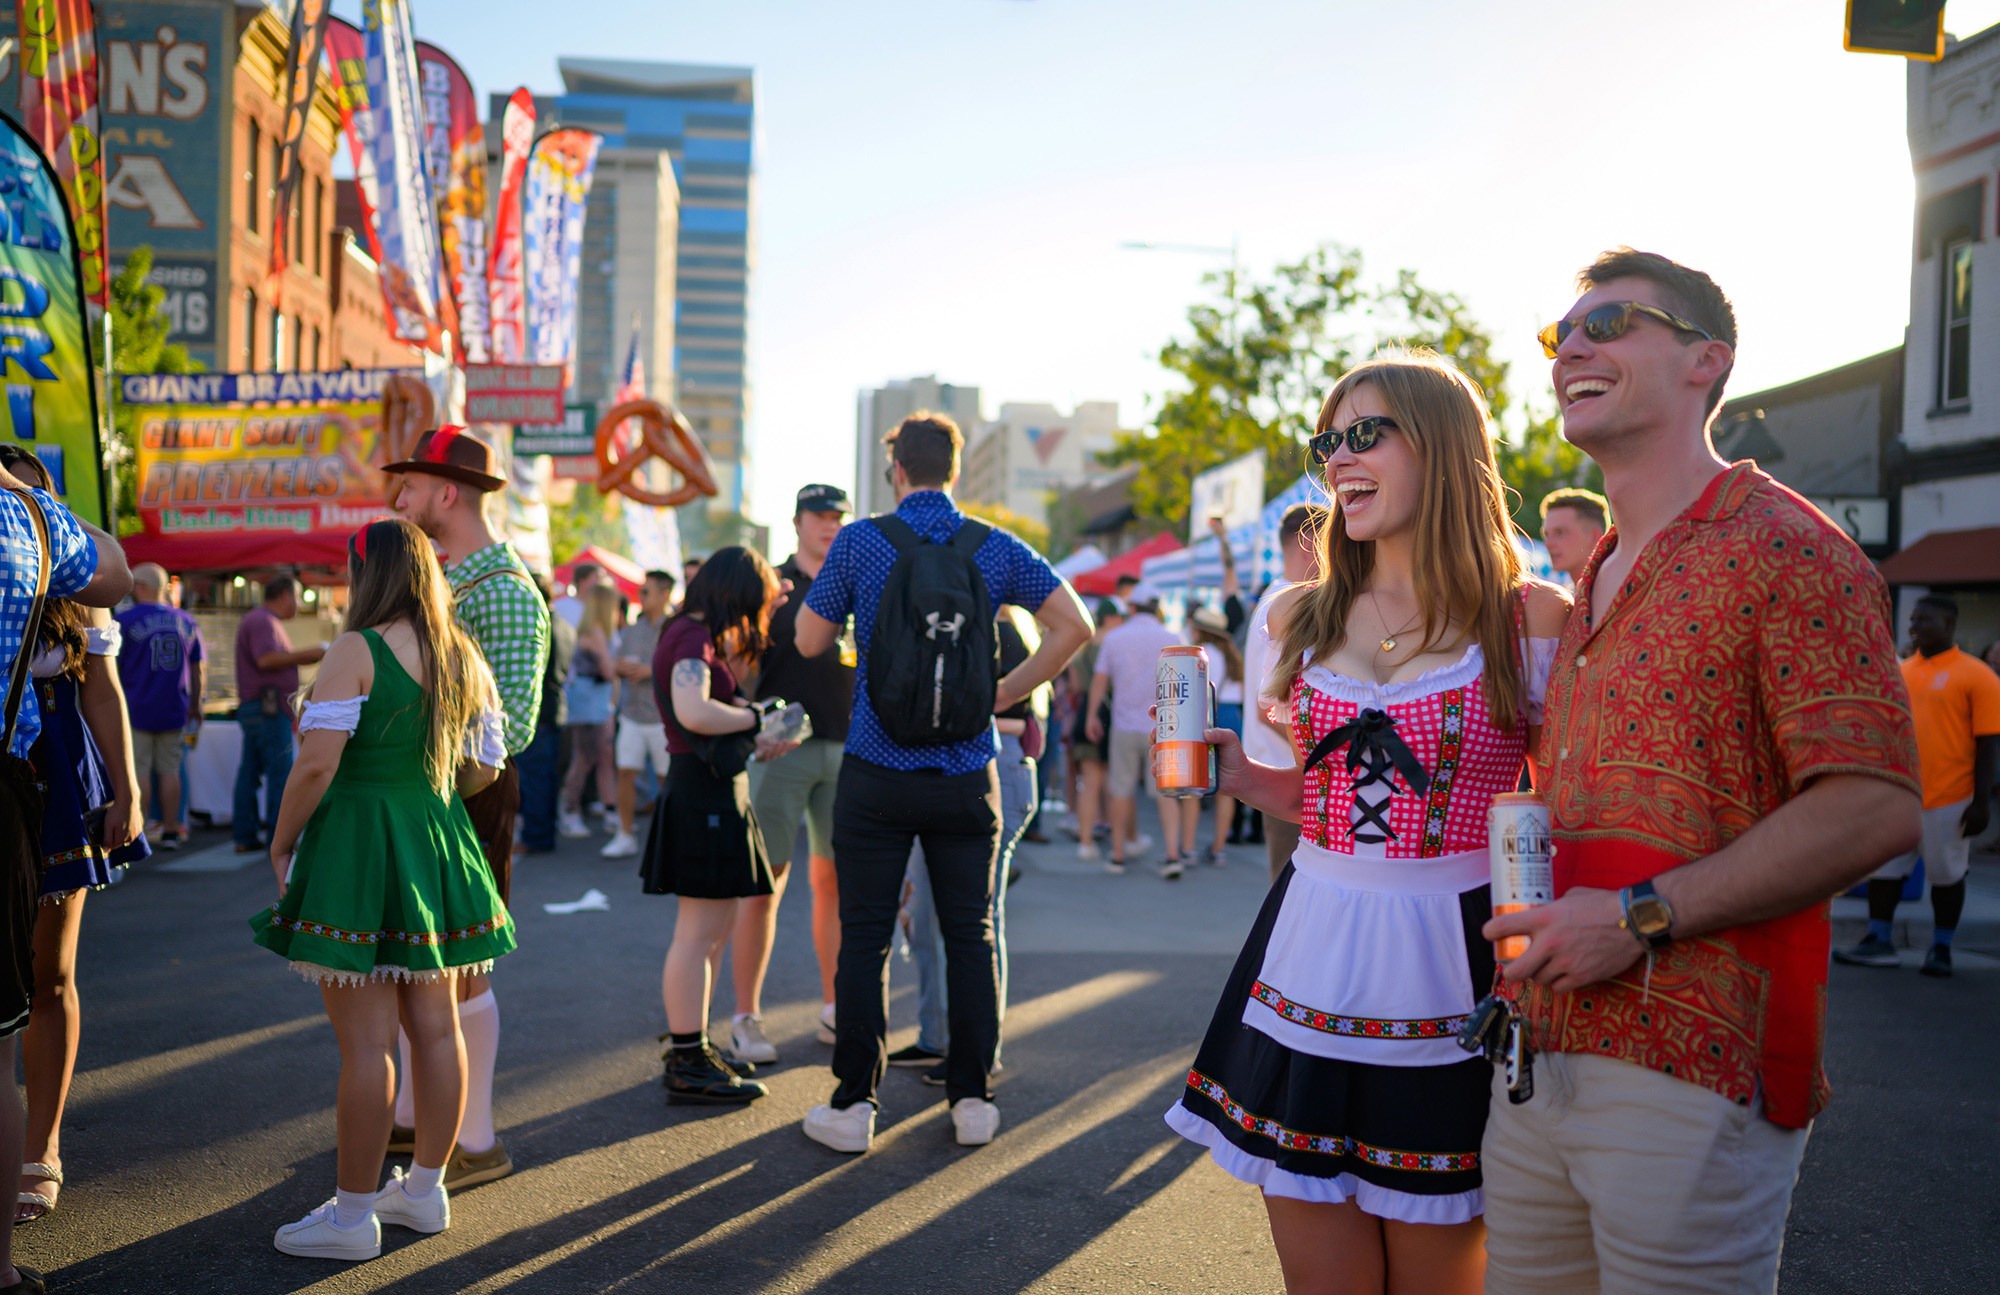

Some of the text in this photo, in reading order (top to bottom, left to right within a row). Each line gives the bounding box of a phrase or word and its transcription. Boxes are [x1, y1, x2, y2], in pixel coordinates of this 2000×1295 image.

[124, 375, 222, 402] GIANT
[142, 414, 326, 450] GIANT SOFT
[143, 458, 342, 506] PRETZELS
[159, 507, 311, 535] Bada-Bing
[150, 632, 183, 671] 19
[1156, 682, 1189, 700] CLINE
